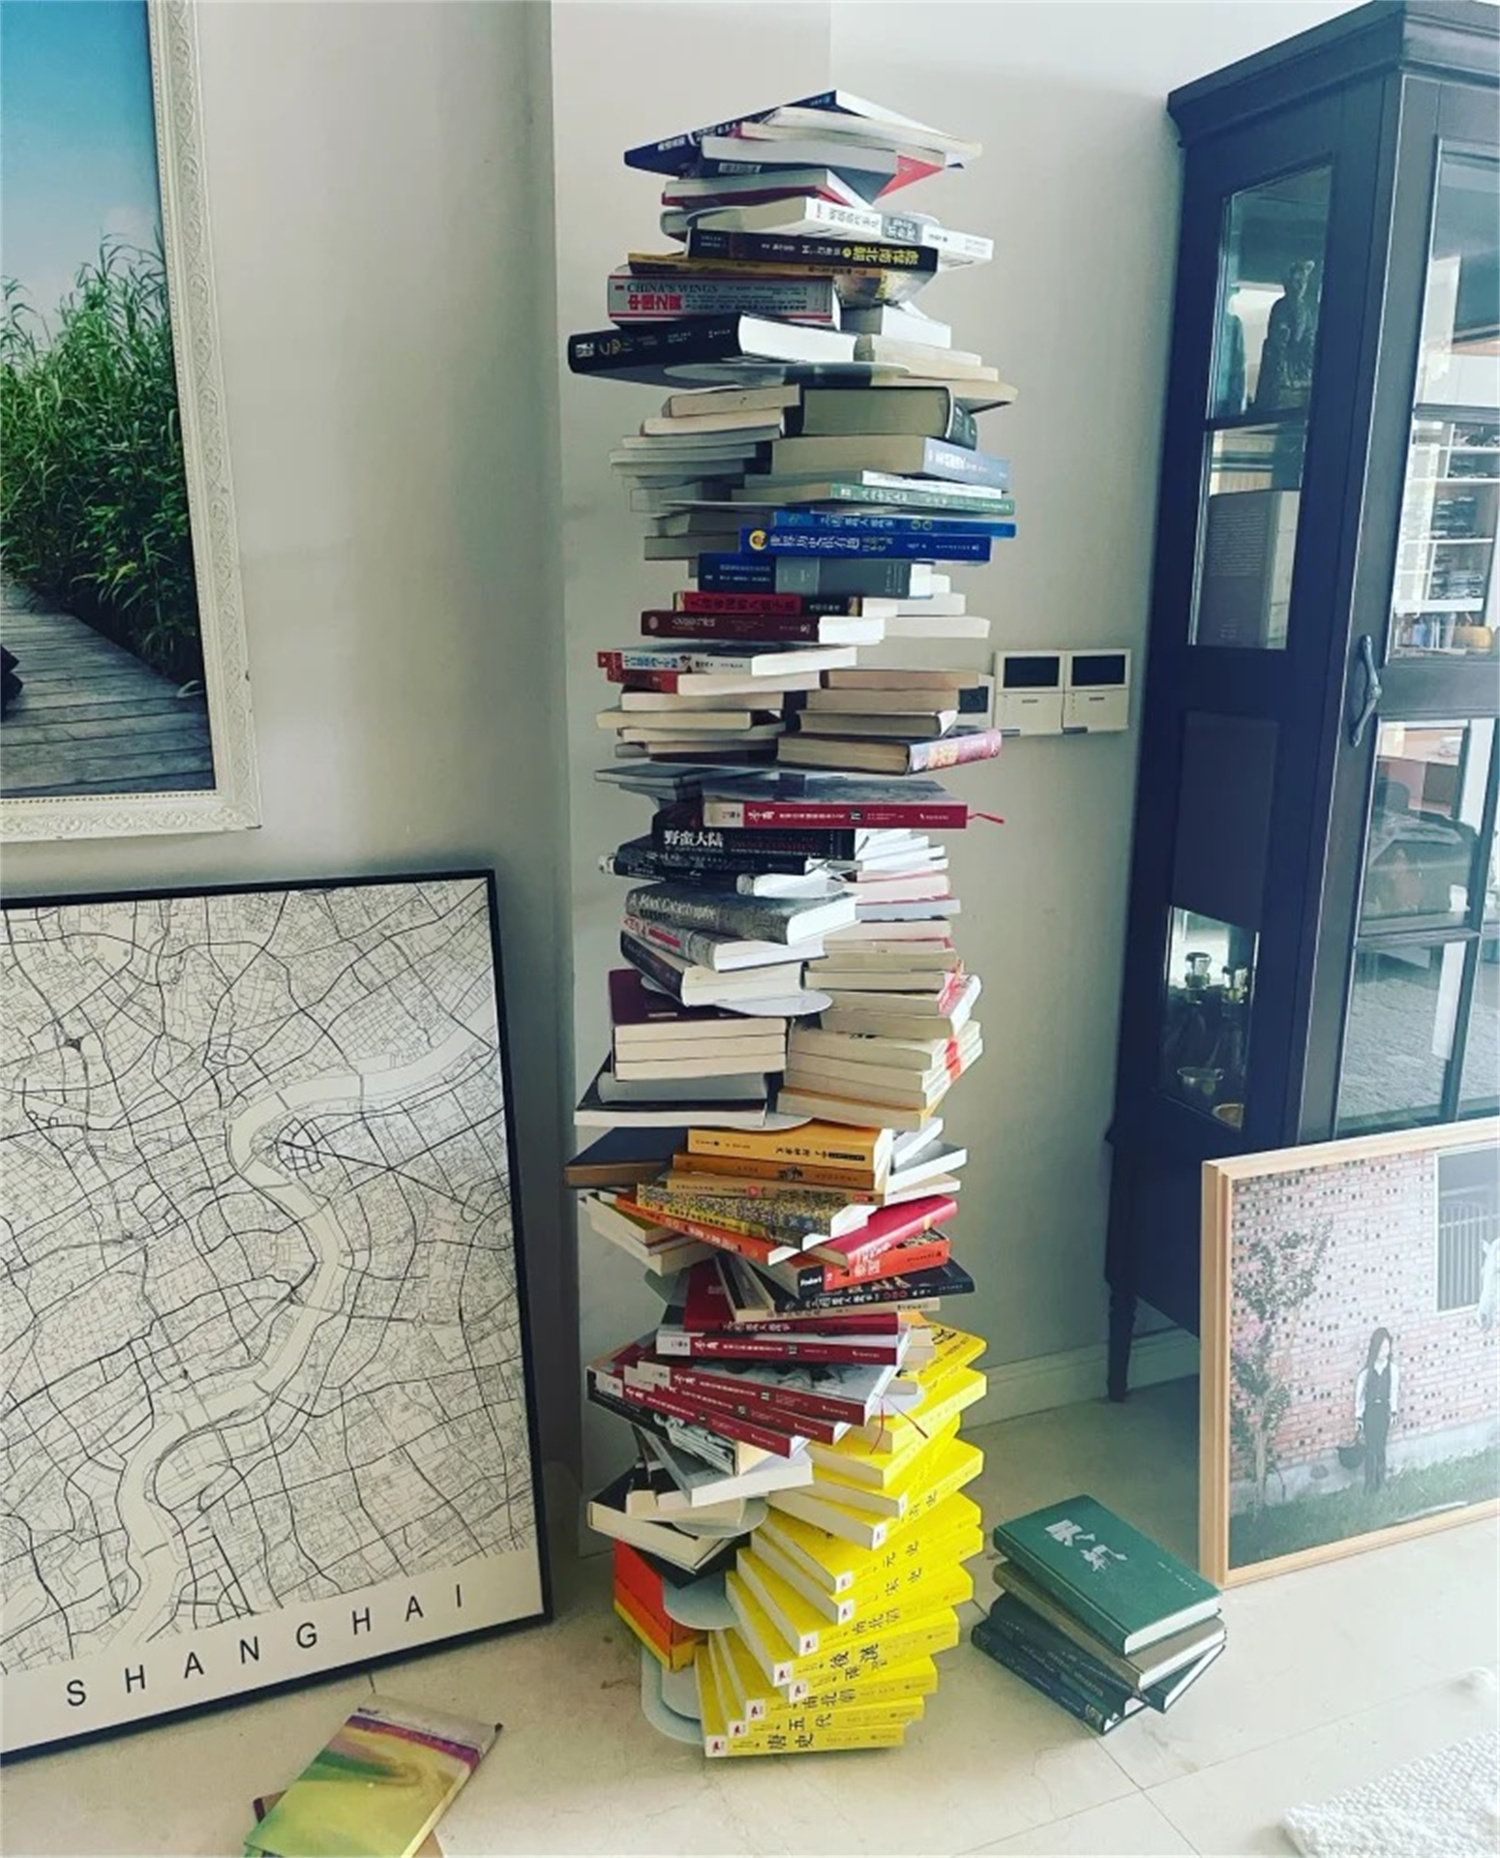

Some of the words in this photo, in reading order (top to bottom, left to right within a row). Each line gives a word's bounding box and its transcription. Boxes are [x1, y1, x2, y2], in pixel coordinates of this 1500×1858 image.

[627, 283, 674, 293] CHINA'S
[678, 283, 718, 293] WINGS
[664, 830, 723, 848] 野蛮大陆
[67, 1584, 461, 1706] SHANGHAI
